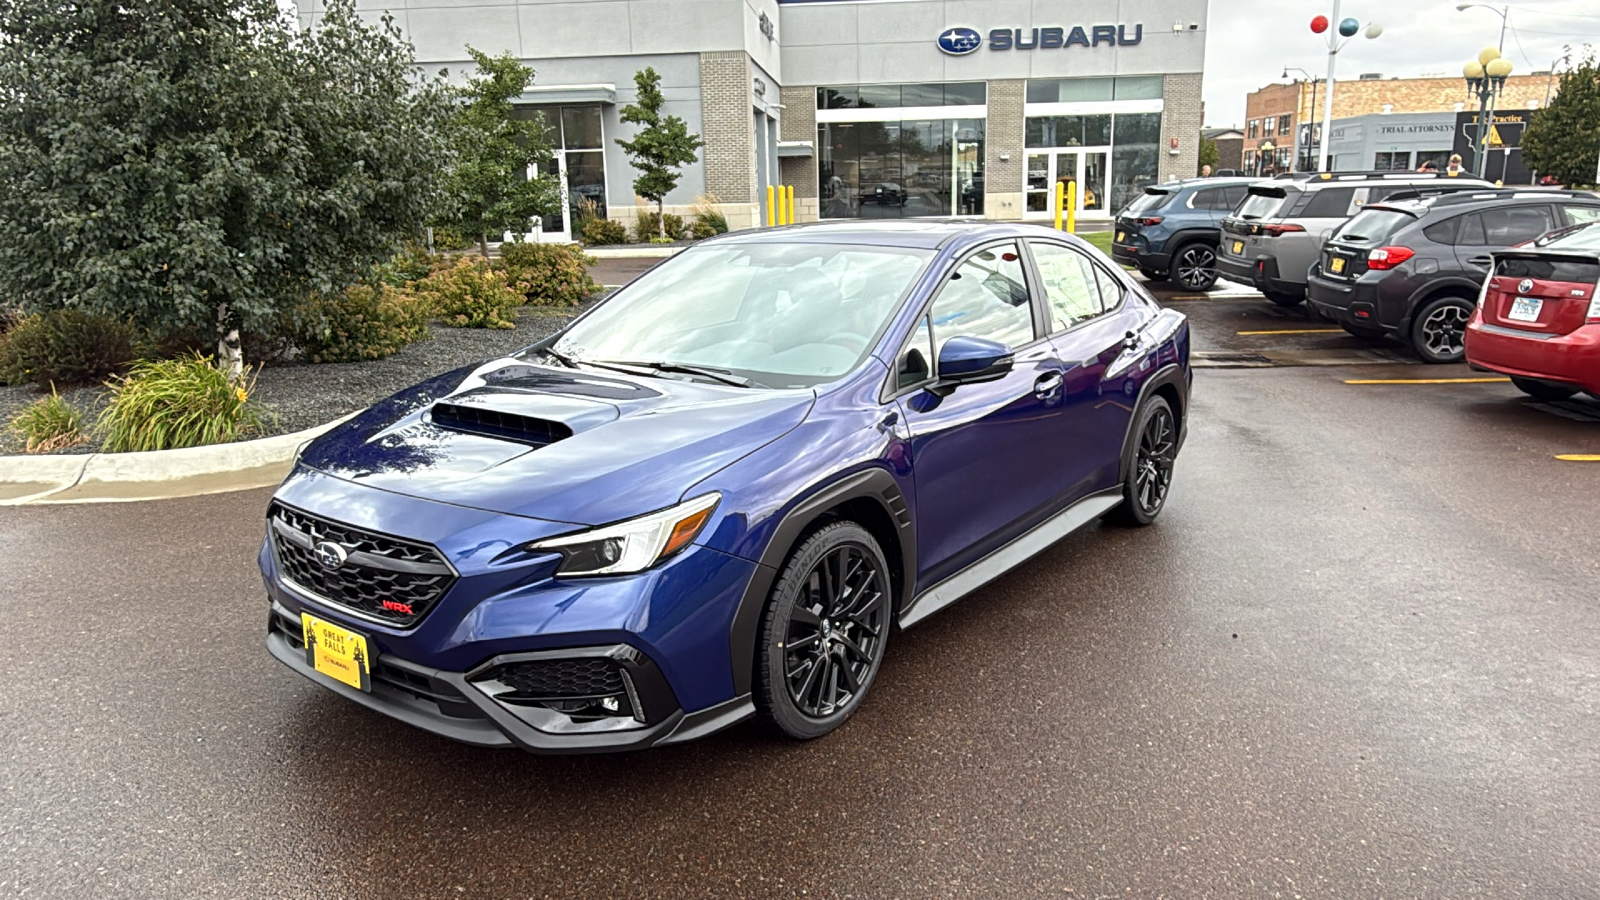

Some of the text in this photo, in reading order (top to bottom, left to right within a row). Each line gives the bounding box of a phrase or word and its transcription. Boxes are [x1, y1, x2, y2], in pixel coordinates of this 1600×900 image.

[988, 23, 1143, 51] SUBARU
[1472, 115, 1488, 123] Te
[1407, 125, 1455, 133] ATTORNEYS
[383, 600, 413, 614] WRX
[323, 628, 344, 644] GREAT
[324, 639, 346, 655] FALLS
[330, 658, 350, 671] SUBARU
